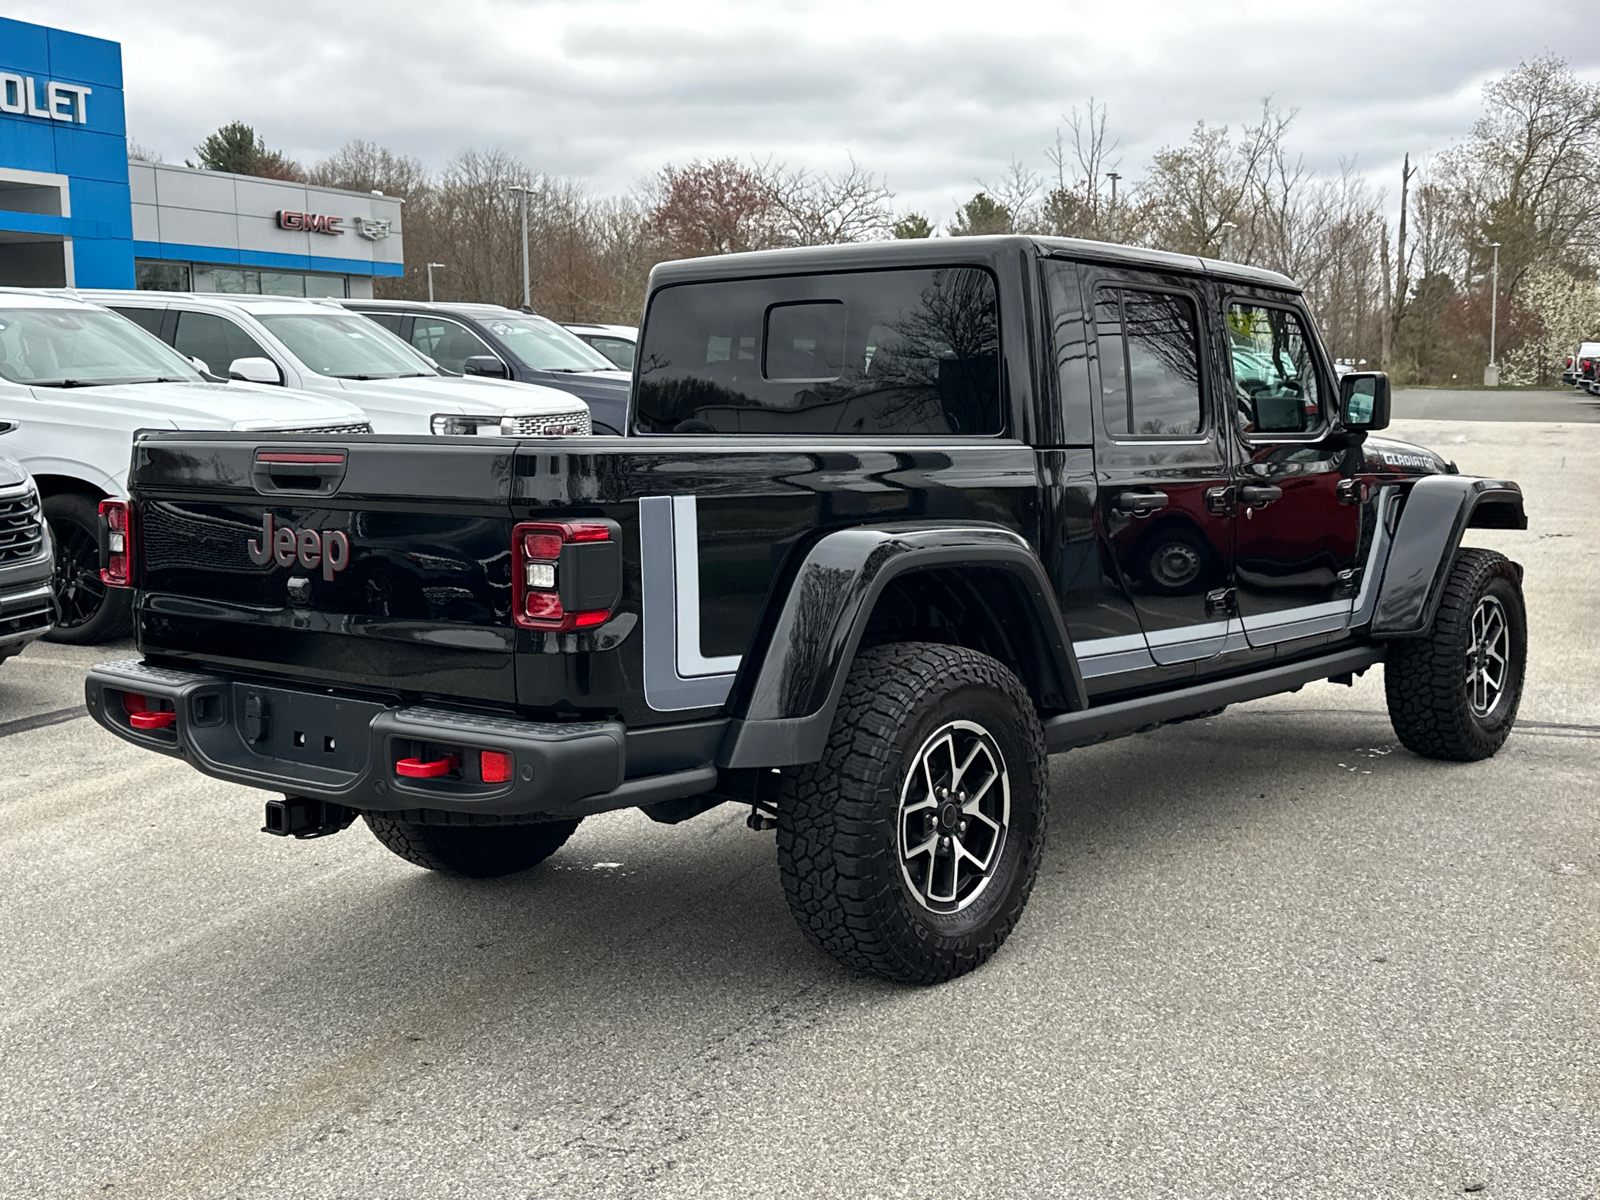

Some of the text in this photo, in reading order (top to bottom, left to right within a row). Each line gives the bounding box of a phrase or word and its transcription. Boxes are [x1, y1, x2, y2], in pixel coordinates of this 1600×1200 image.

[277, 210, 344, 235] GMC
[1382, 453, 1436, 469] GLADIATOR
[248, 513, 349, 581] Jeep
